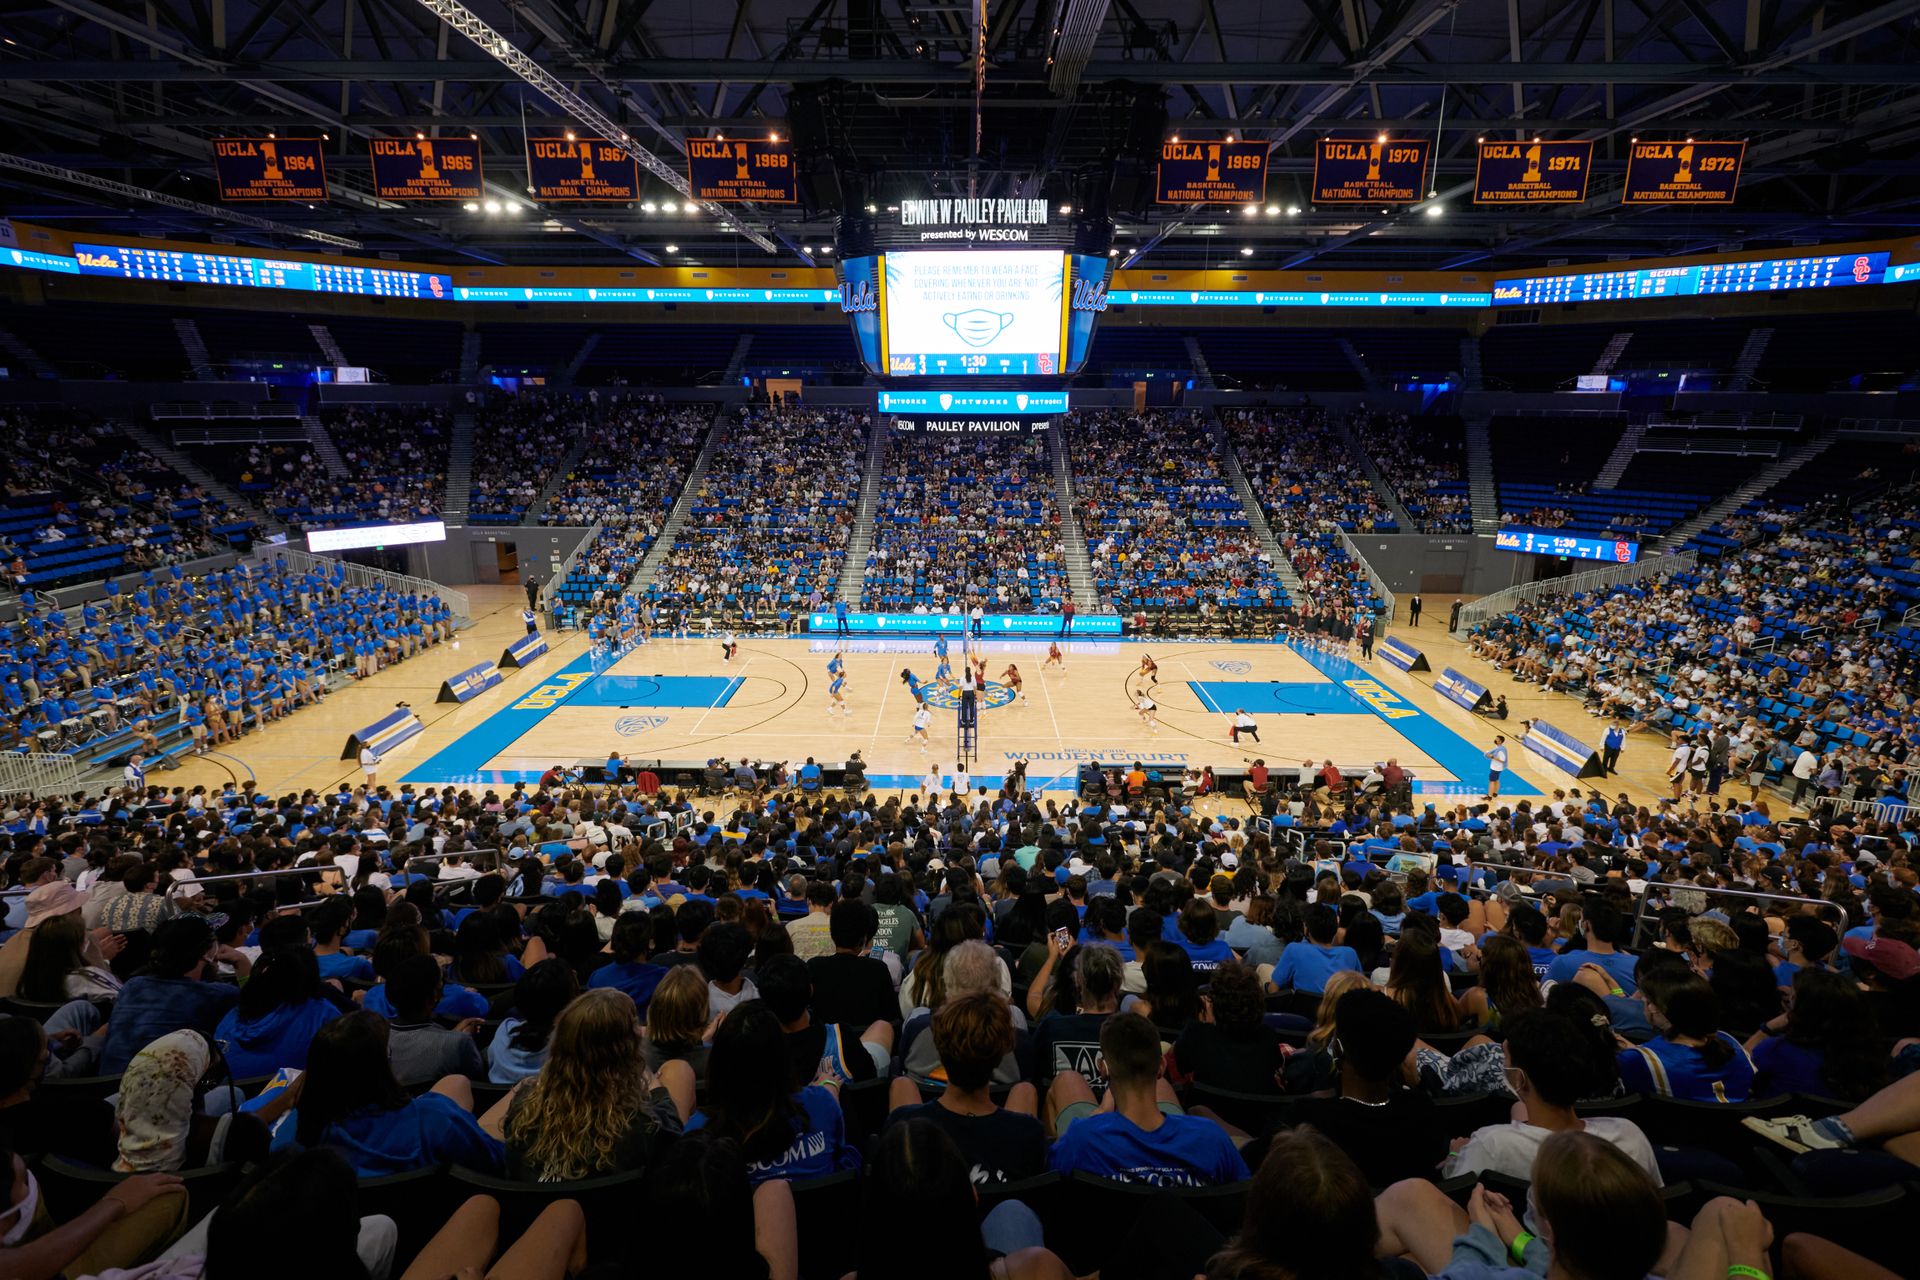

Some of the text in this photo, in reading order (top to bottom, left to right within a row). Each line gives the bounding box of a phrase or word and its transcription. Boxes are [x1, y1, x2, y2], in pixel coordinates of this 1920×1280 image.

[217, 142, 258, 157] UCLA
[374, 141, 416, 155] UCLA
[535, 142, 578, 158] UCLA
[599, 147, 628, 162] 1967
[691, 142, 732, 158] UCLA
[1162, 144, 1203, 160] UCLA
[1325, 144, 1367, 160] UCLA
[1483, 145, 1521, 159] UCLA
[1635, 145, 1673, 159] UCLA
[283, 156, 315, 170] 1964
[441, 155, 473, 170] 1965
[755, 153, 788, 168] 1968
[1226, 154, 1261, 169] 1969
[1388, 149, 1419, 163] 1970
[1548, 156, 1581, 171] 1971
[1699, 157, 1735, 171] 1972
[250, 179, 294, 187] BASKETBALL
[406, 178, 451, 187] BASKETBALL
[225, 187, 323, 197] NATIONAL CHAMPIONS
[381, 187, 479, 197] NATIONAL CHAMPIONS
[540, 186, 631, 197] NATIONAL CHAMPIONS
[701, 188, 785, 199] NATIONAL CHAMPIONS
[1167, 190, 1254, 200] NATIONAL CHAMPIONS
[1321, 188, 1414, 198] NATIONAL CHAMPIONS
[1481, 190, 1578, 199] NATIONAL CHAMPIONS
[1633, 190, 1726, 199] NATIONAL CHAMPIONS
[902, 198, 1048, 225] EDWIN W PAULEY PAVILION
[921, 229, 1029, 241] presented by WESCOM
[76, 252, 119, 268] Ucla
[981, 265, 990, 275] TO
[991, 265, 1013, 275] WEAR
[1021, 265, 1039, 275] FACE
[1650, 268, 1688, 278] SCORE
[914, 278, 1039, 288] COVERING WHENEVER YOU ARE NOT
[838, 281, 877, 312] Ucla
[923, 291, 1030, 301] ACTIVELY EATING OR DRINKING
[1072, 279, 1108, 312] Ucla
[1494, 286, 1522, 299] Ucla
[889, 358, 916, 372] Ucla
[919, 360, 927, 375] 3
[960, 355, 987, 367] 1:30
[1022, 360, 1028, 374] 1
[926, 421, 1020, 431] PAULEY PAVILION
[1496, 533, 1520, 547] Ucla
[1525, 539, 1533, 552] 3
[1553, 537, 1577, 548] 1:30
[512, 671, 594, 710] UCLA
[1341, 679, 1420, 720] UCLA
[1003, 751, 1190, 762] WOODEN COURT
[878, 917, 899, 925] NGELES
[873, 938, 889, 947] PARIS
